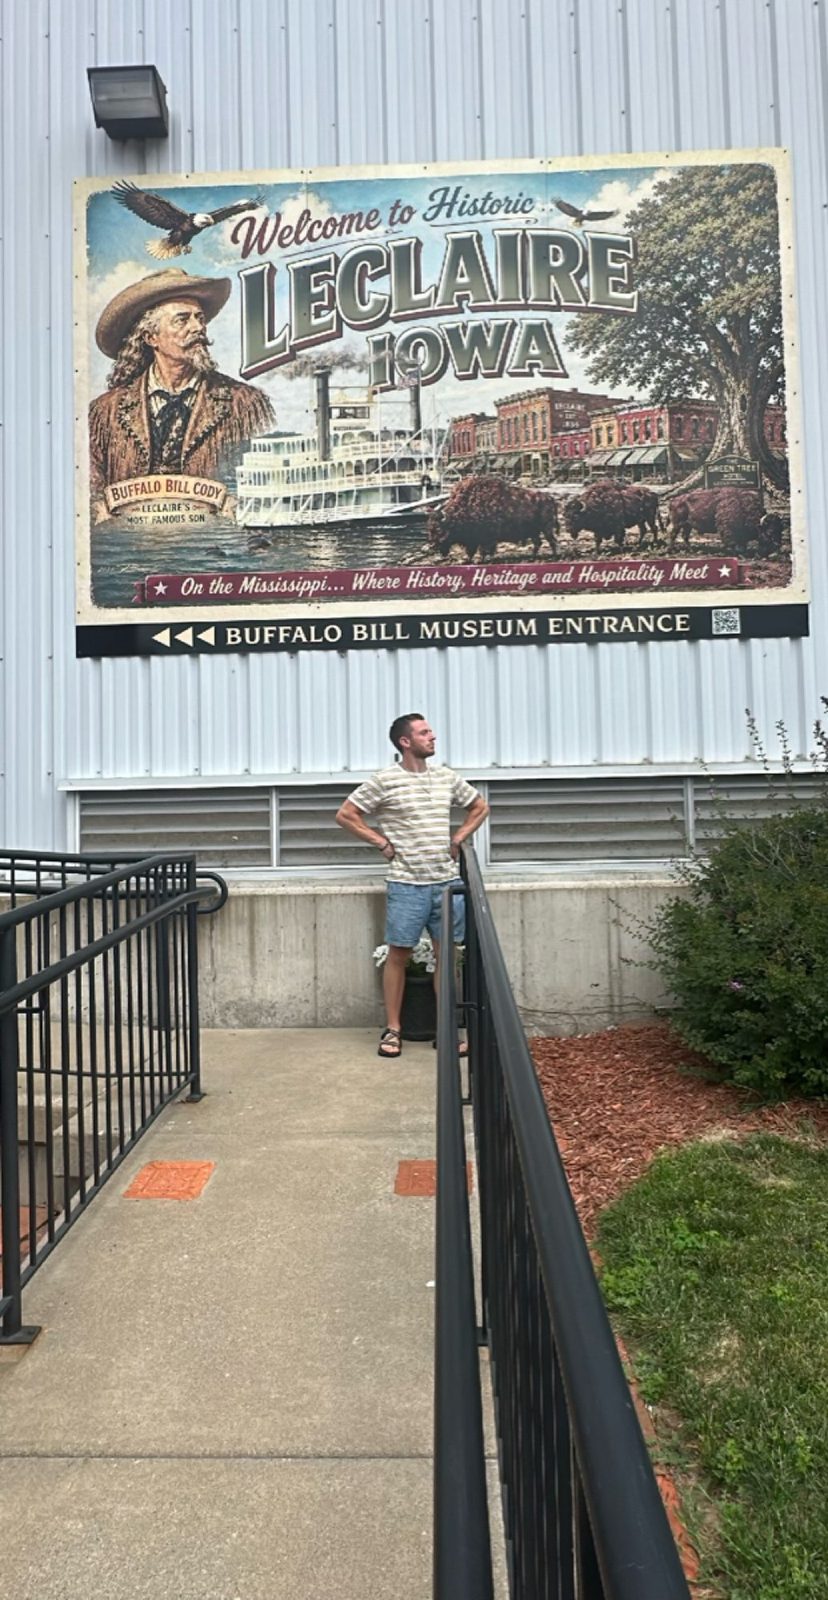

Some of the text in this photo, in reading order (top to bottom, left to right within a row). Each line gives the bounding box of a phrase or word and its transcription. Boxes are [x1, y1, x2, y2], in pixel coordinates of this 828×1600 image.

[231, 186, 534, 258] Welcome to Historic
[238, 228, 639, 379] LECLAIRE
[366, 318, 569, 393] IOWA
[111, 479, 223, 501] BUFFALO BILL CODY
[128, 514, 205, 525] MOST FAMOUS SON
[142, 503, 190, 512] LECLAIRE'S
[180, 561, 709, 598] On the Mississippi... Where History, Heritage and Hospitality Meet
[225, 613, 691, 645] BUFFALO BILL MUSEUM ENTRANCE
